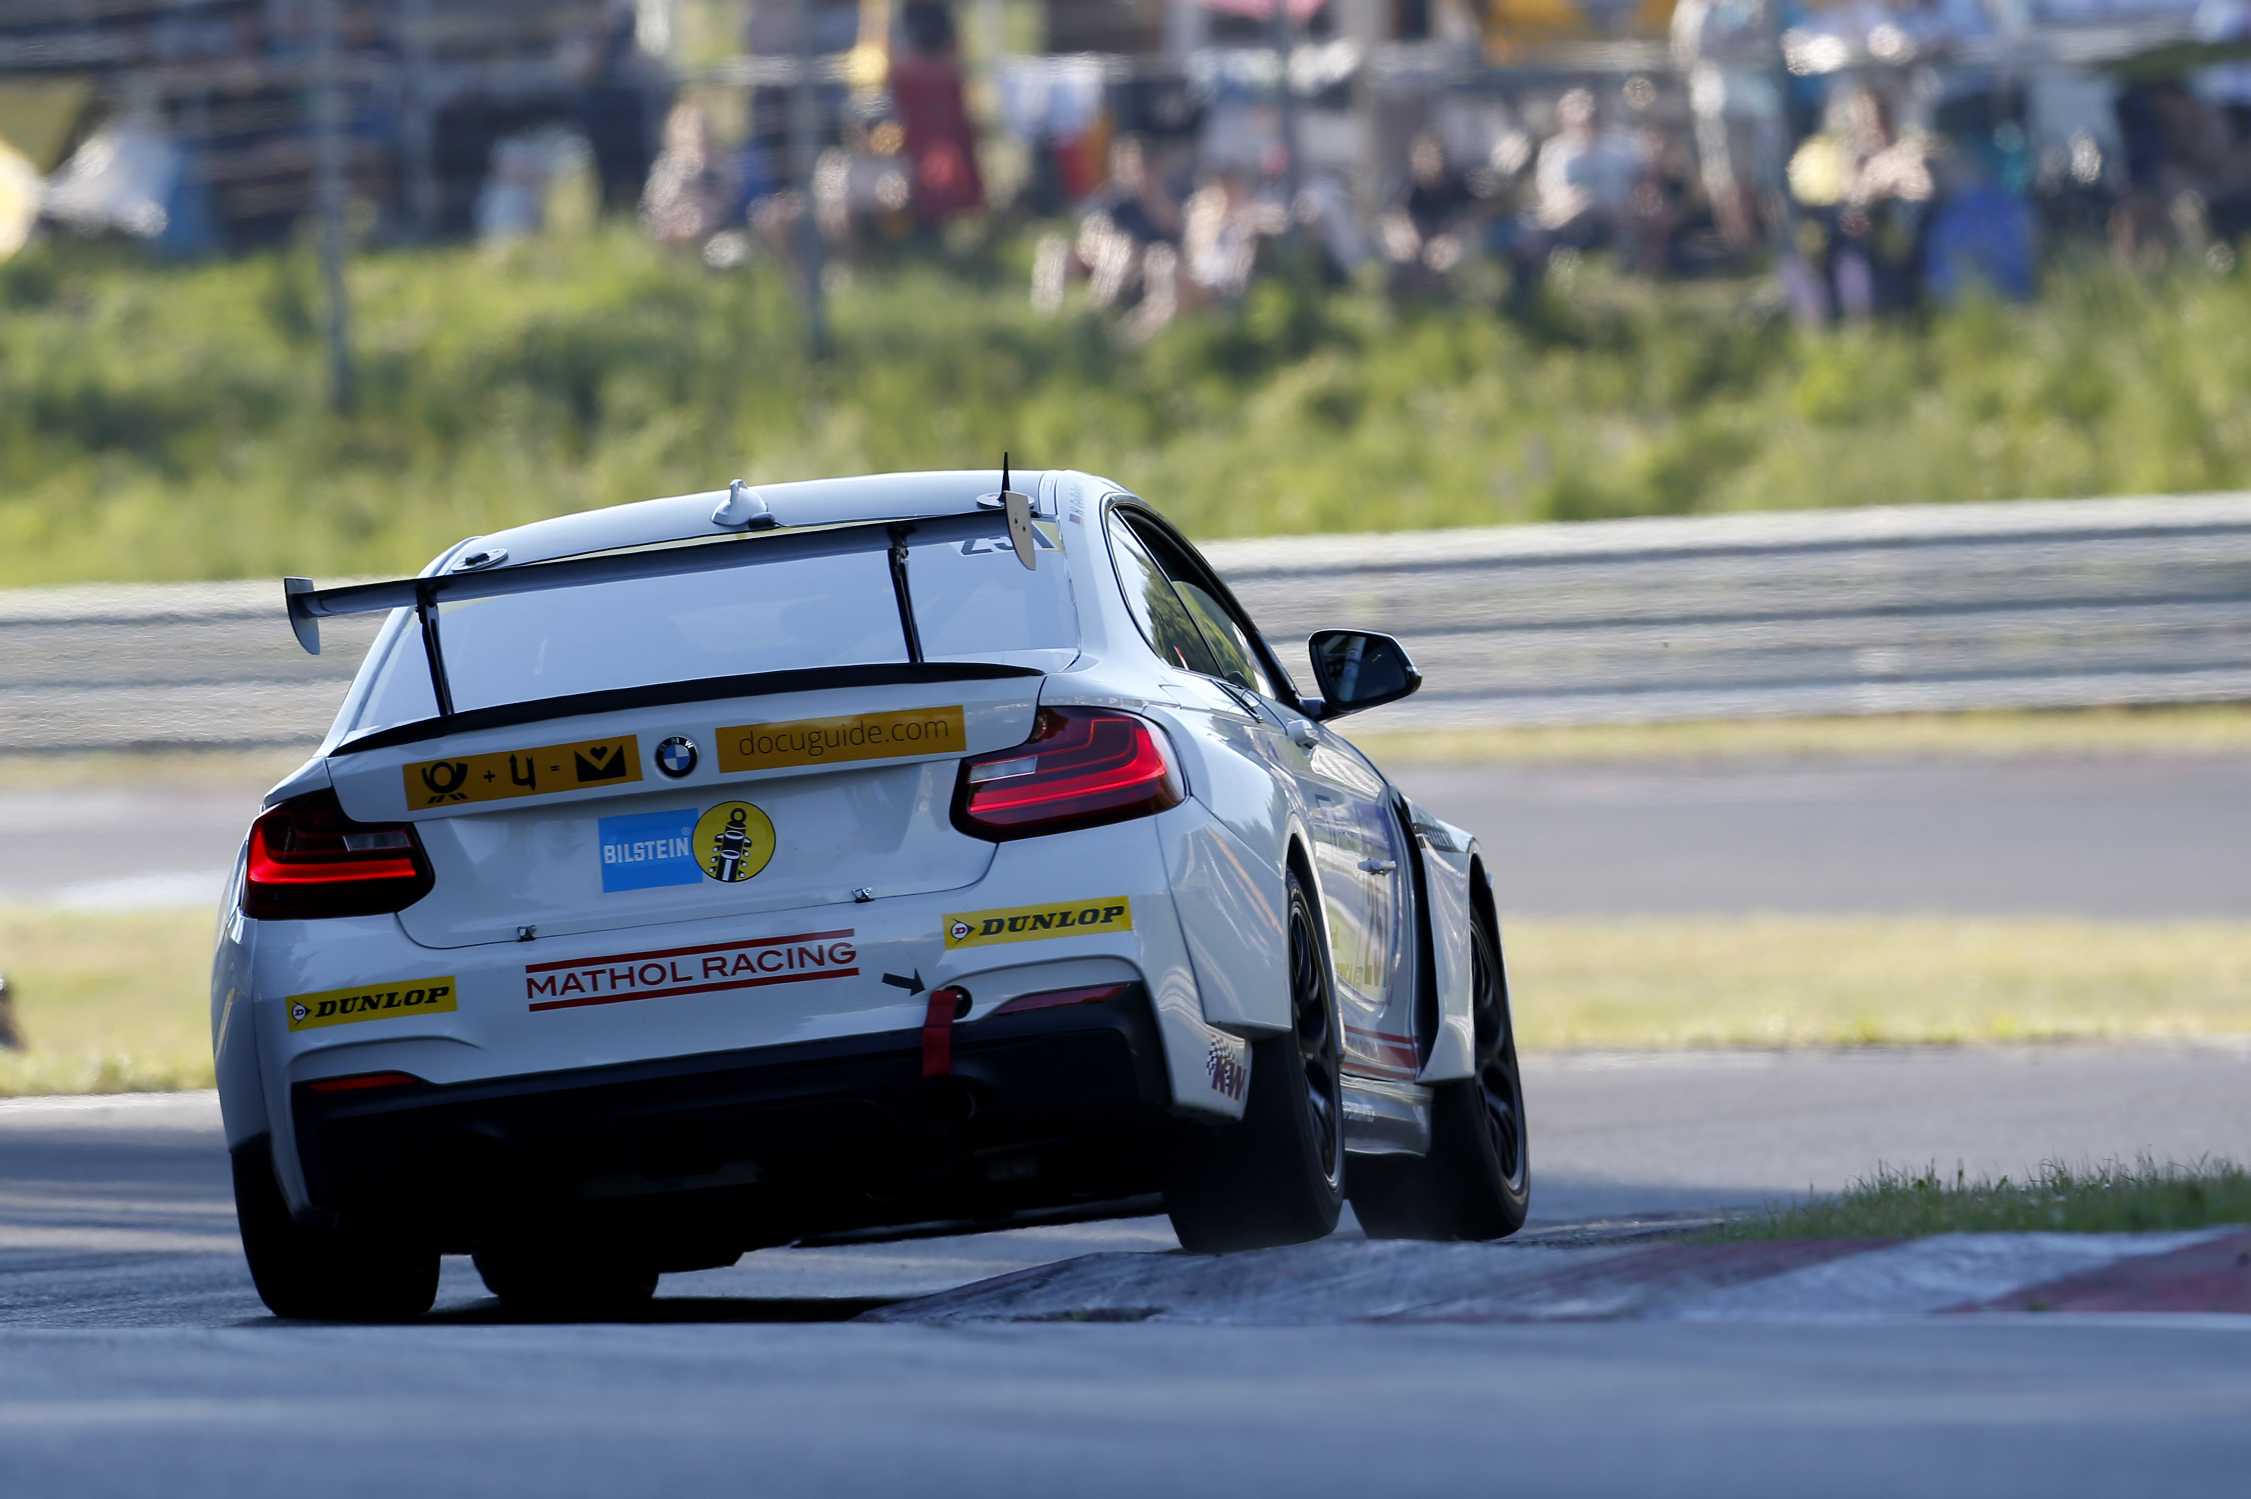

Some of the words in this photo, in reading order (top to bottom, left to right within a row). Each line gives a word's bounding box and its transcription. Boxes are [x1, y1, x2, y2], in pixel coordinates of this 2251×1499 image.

[738, 717, 950, 758] docuguide.com
[603, 837, 689, 864] BILSTEIN
[979, 906, 1125, 936] DUNLOP
[525, 961, 693, 999] MATHOL
[702, 943, 857, 980] RACING
[315, 986, 450, 1018] DUNLOP
